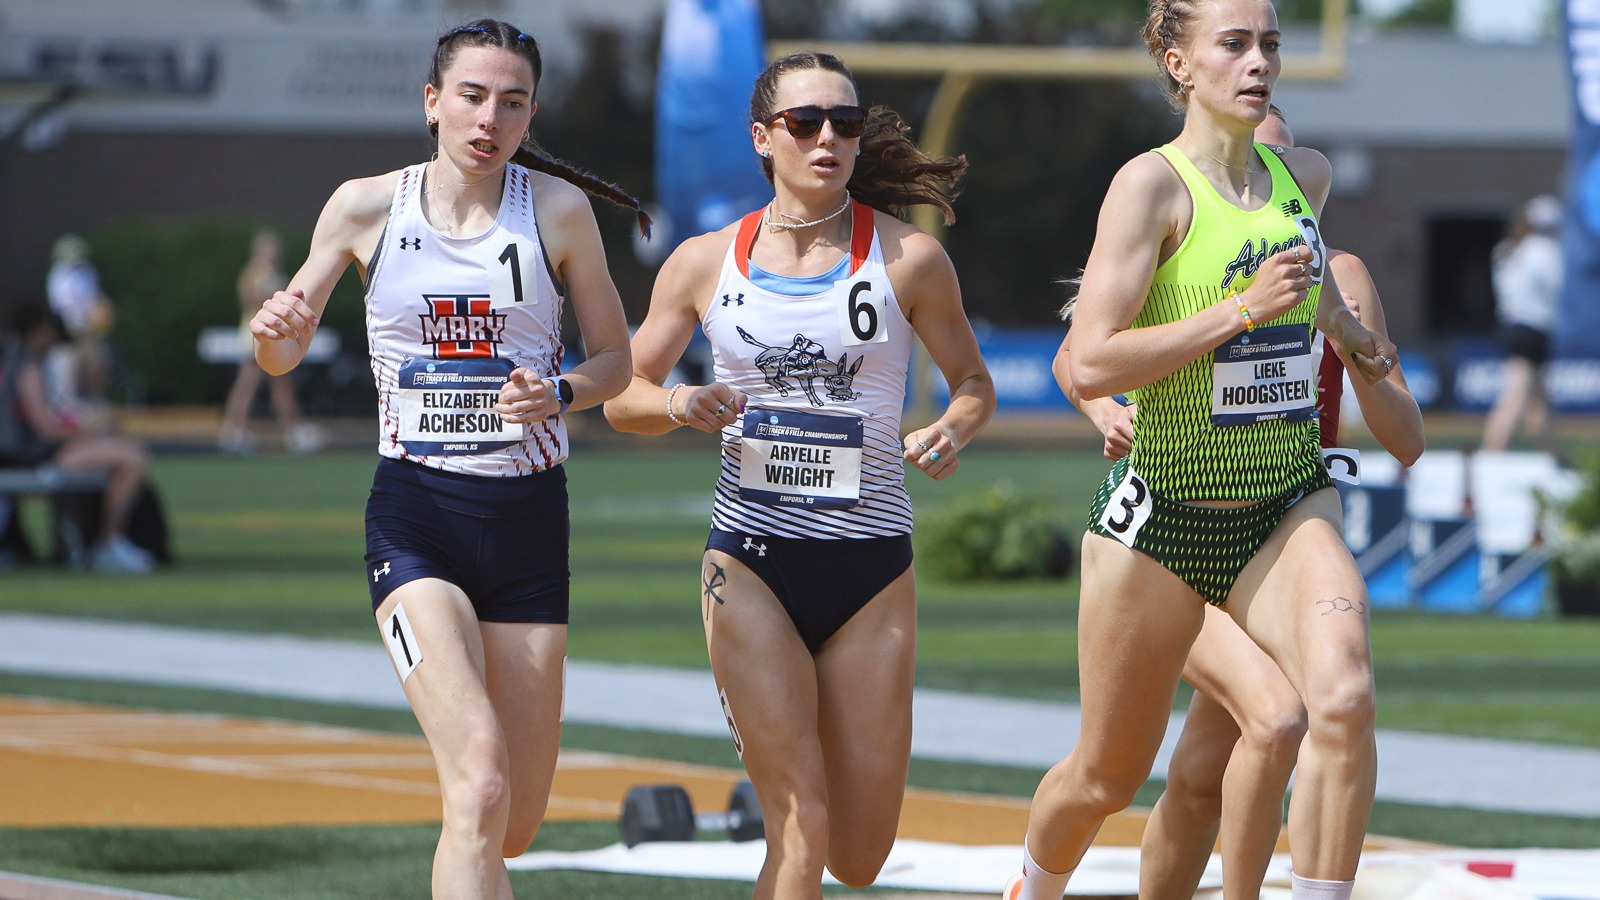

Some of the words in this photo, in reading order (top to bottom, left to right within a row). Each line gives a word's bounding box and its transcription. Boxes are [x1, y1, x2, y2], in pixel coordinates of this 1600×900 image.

[498, 243, 523, 302] 1
[848, 281, 878, 341] 6
[419, 314, 508, 345] MARY
[1272, 341, 1303, 351] CHAMPIONSHIPS
[425, 375, 443, 383] TRACK
[448, 375, 463, 383] FIELD
[1254, 361, 1286, 380] LIEKE
[423, 392, 499, 409] ELIZABETH
[1222, 379, 1309, 406] HOOGSTEEN
[418, 413, 503, 433] ACHESON
[768, 427, 785, 435] TRACK
[804, 431, 848, 440] CHAMPIONSHIPS
[769, 444, 832, 464] ARYELLE
[765, 464, 835, 488] WRIGHT
[1107, 476, 1146, 534] 3
[392, 613, 413, 668] 1
